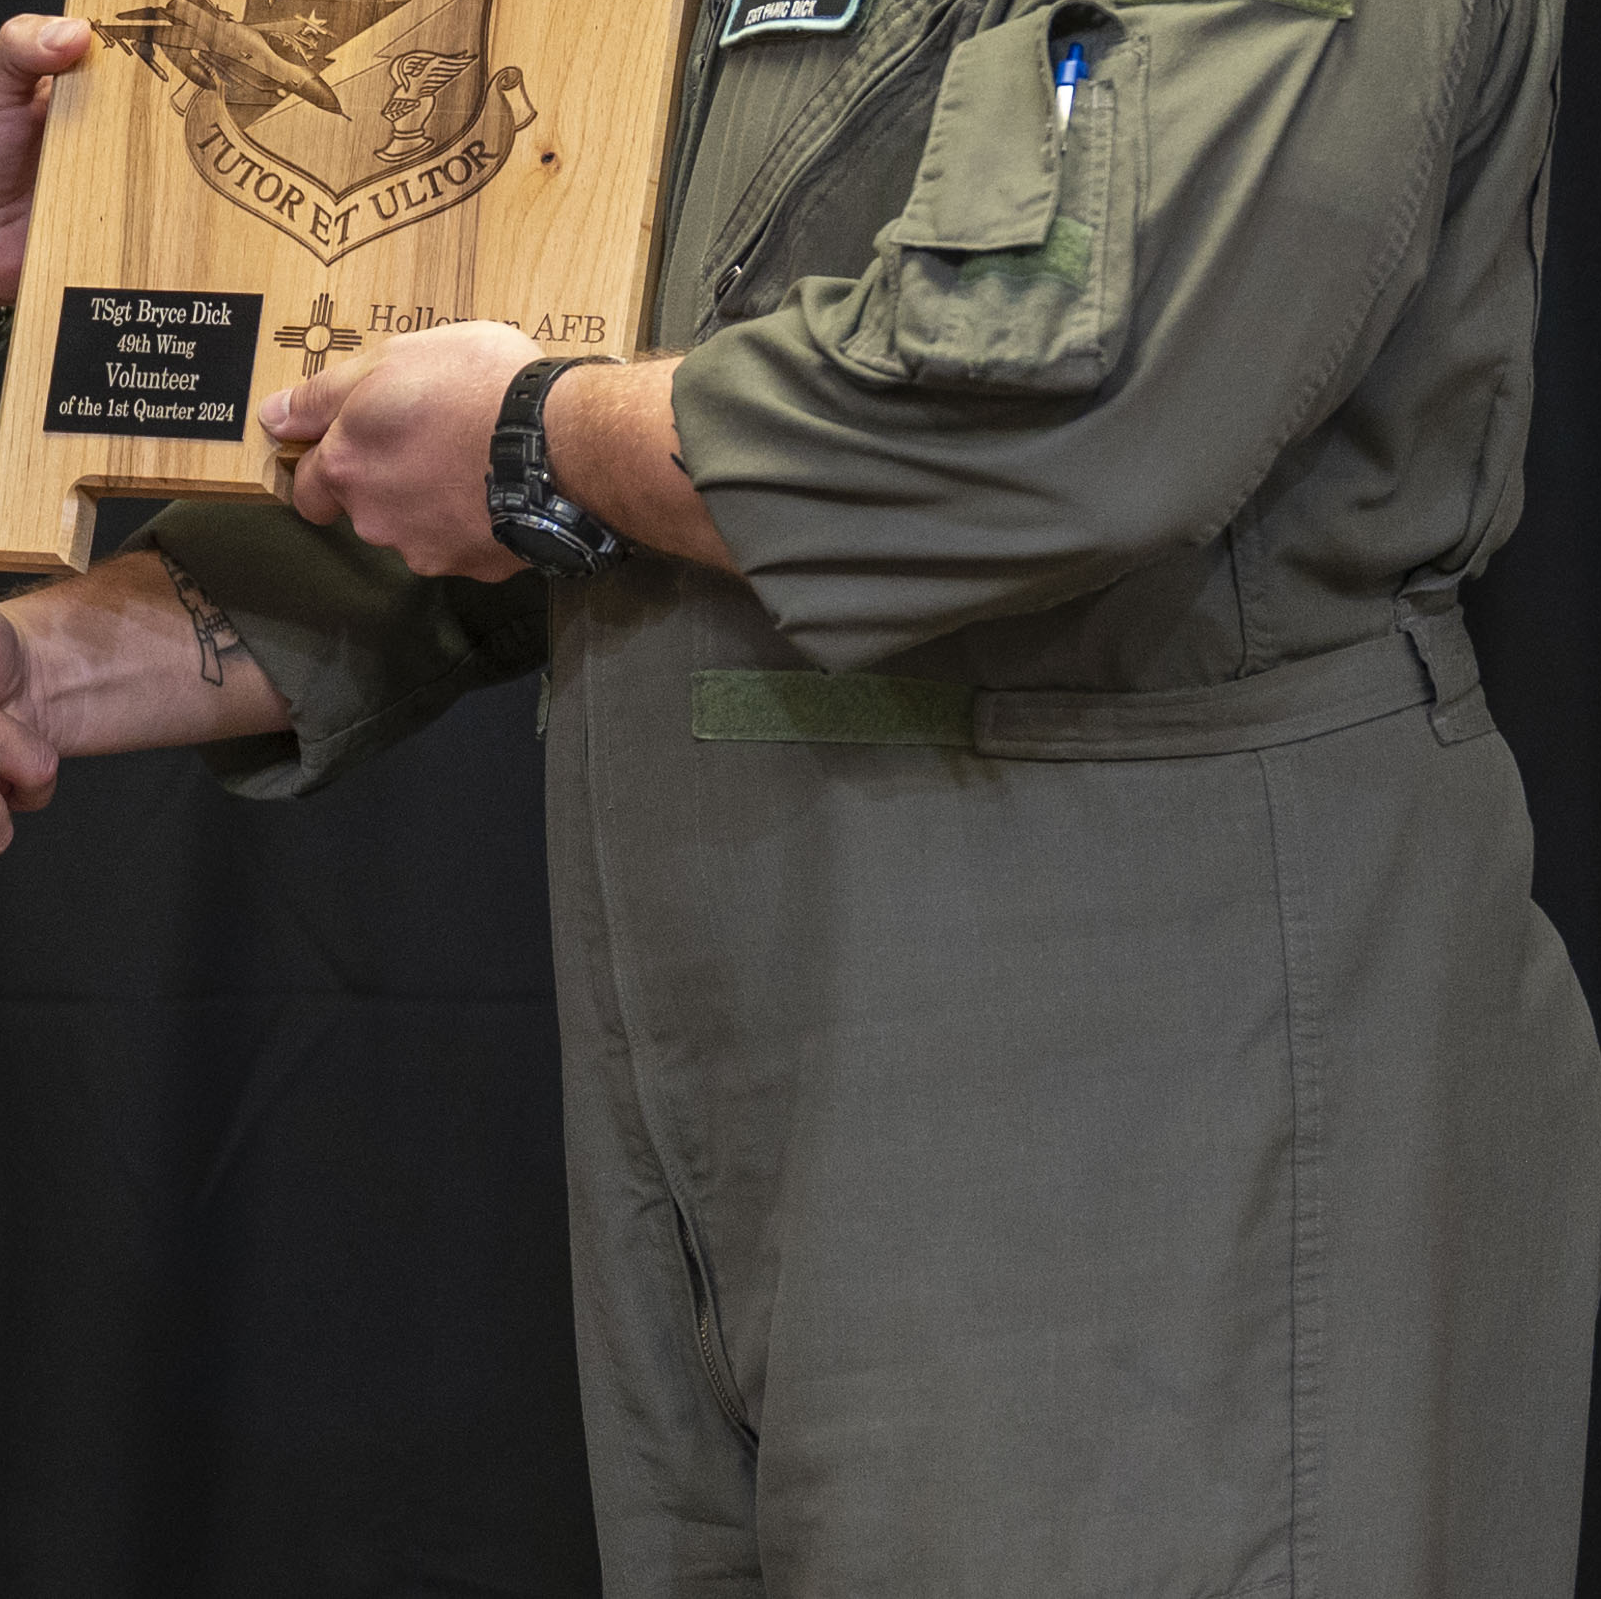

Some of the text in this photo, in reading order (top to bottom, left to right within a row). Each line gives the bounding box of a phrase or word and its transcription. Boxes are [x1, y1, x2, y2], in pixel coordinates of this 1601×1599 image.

[790, 0, 818, 18] DICK
[197, 122, 498, 246] TUTOR ET ULTOR
[91, 298, 232, 328] TSgt Bryce Dick
[531, 313, 606, 343] AFB
[116, 333, 197, 359] 49th Wing
[105, 362, 200, 391] Volunteer
[59, 396, 235, 422] of the 1st Quarter 2024
